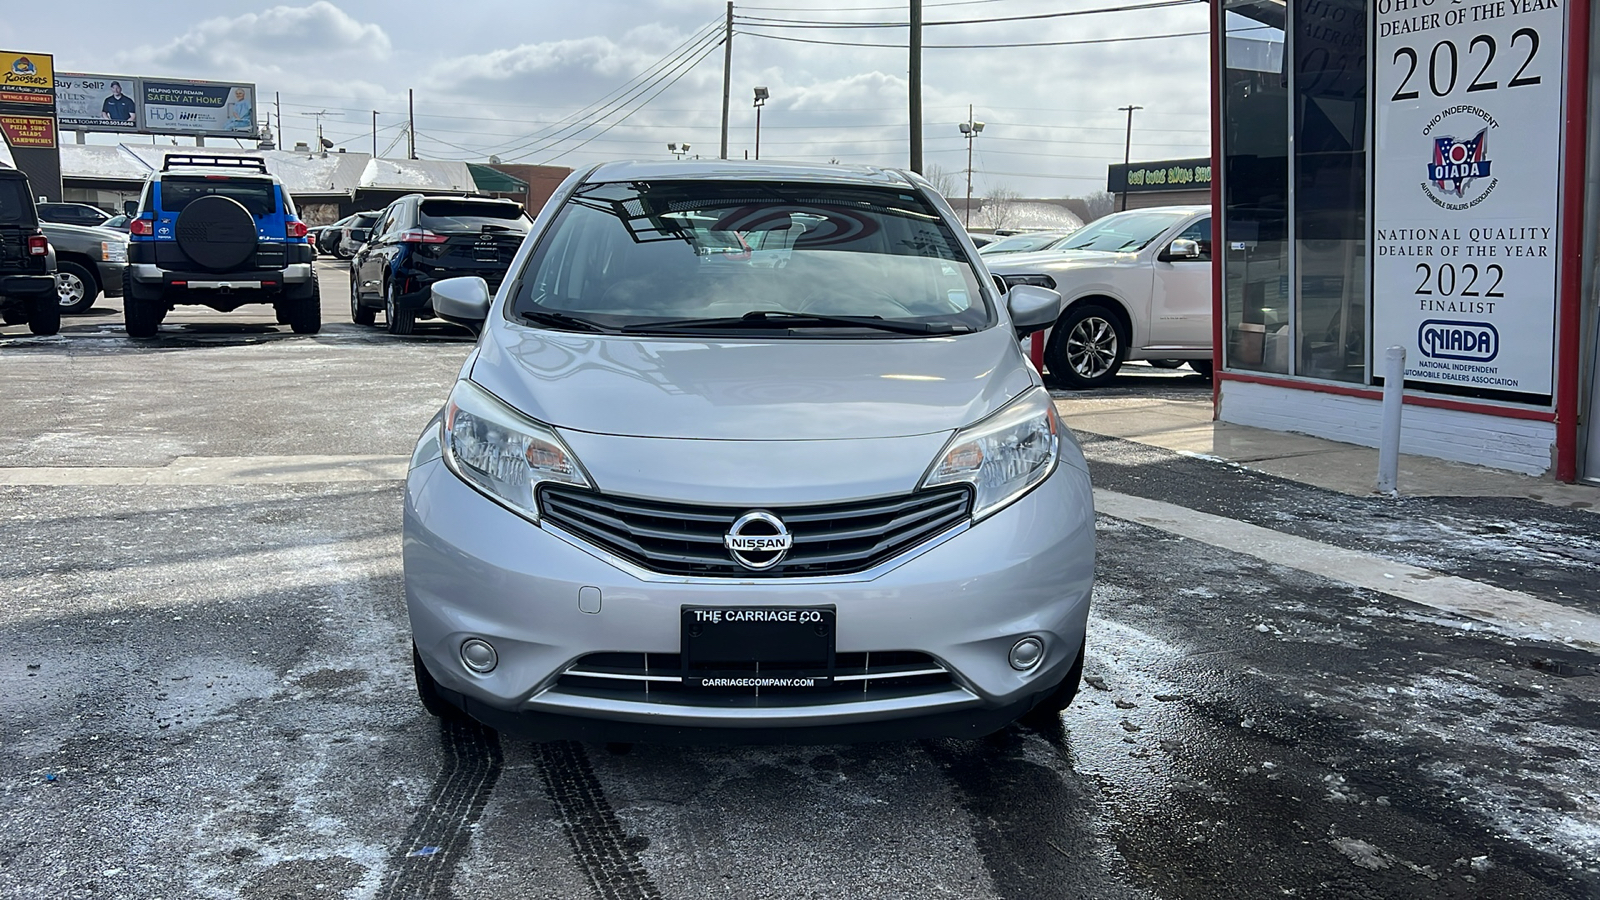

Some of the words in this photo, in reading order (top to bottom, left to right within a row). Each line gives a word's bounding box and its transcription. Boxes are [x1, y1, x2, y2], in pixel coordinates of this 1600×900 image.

[1380, 13, 1441, 37] DEALER
[1445, 8, 1467, 26] OF
[1471, 1, 1506, 22] THE
[1510, 0, 1559, 15] YEAR
[1391, 28, 1542, 101] 2022
[2, 71, 48, 85] Roosters
[54, 79, 72, 89] Buy
[82, 81, 105, 90] Sell?
[147, 93, 180, 102] SAFELY
[150, 107, 174, 120] Hub
[1422, 114, 1442, 136] OHIO
[1442, 105, 1499, 129] INDEPENDENT
[1194, 166, 1211, 183] SHO
[1435, 162, 1480, 179] OIADA
[1420, 182, 1446, 209] AUTOMOBILE
[1446, 203, 1469, 211] DEALERS
[1469, 178, 1499, 208] ASSOCIATION
[1377, 229, 1461, 240] NATIONAL
[1469, 228, 1551, 242] QUALITY
[1379, 246, 1433, 256] DEALER
[1440, 246, 1459, 257] OF
[1466, 246, 1497, 257] THE
[1505, 246, 1548, 257] YEAR
[1414, 262, 1505, 298] 2022
[1420, 300, 1496, 314] FINALIST
[1424, 328, 1491, 354] NIADA
[1419, 361, 1451, 370] NATIONAL
[1452, 363, 1498, 374] INDEPENDENT
[1442, 373, 1470, 382] DEALERS
[1471, 376, 1519, 387] ASSOCIATION
[731, 538, 786, 548] NISSAN
[694, 610, 722, 622] THE
[725, 610, 797, 622] CARRIAGE
[799, 610, 824, 622] CO.
[701, 678, 815, 687] CARRIAGECOMPANY.COM
